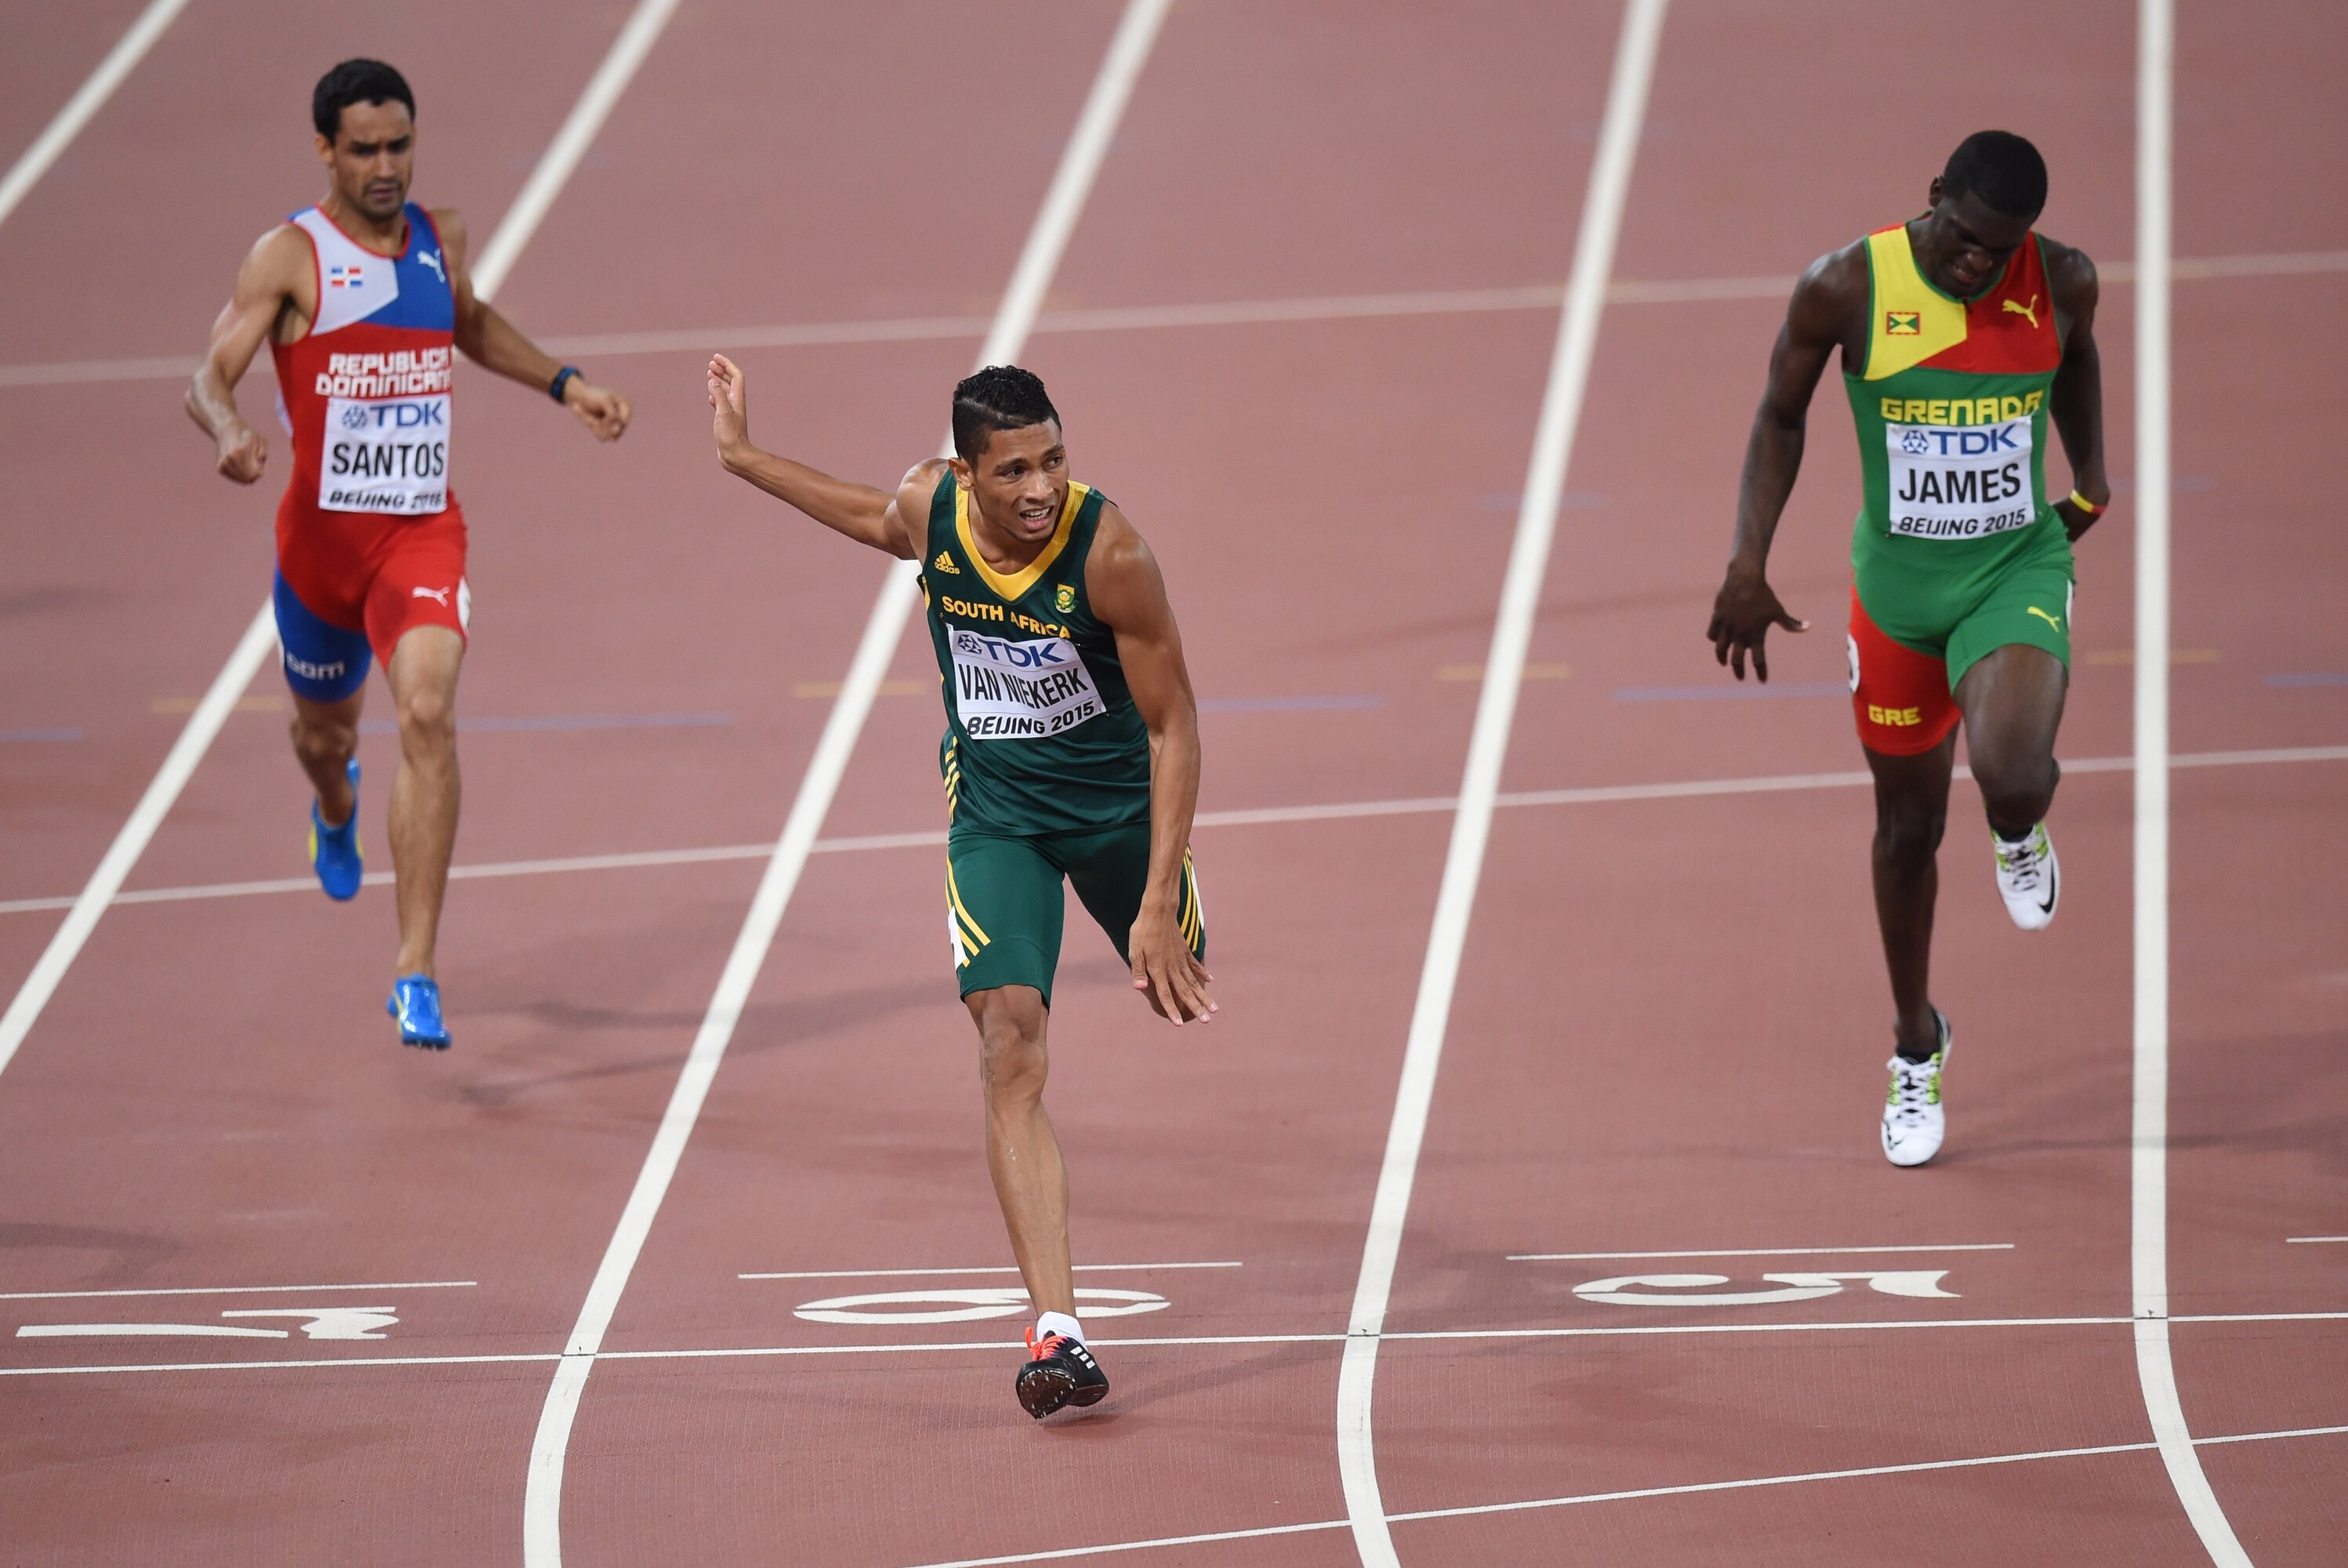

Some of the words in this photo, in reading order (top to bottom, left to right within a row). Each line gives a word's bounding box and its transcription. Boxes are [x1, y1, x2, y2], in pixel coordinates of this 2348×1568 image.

[315, 368, 452, 397] DOMINICAN
[369, 401, 444, 427] TDK
[1881, 390, 2043, 426] GRENADA
[1929, 424, 2018, 456] TDK
[332, 442, 445, 477] SANTOS
[329, 488, 406, 509] BEIJING
[1898, 463, 2021, 504] JAMES
[1899, 516, 1978, 535] BEIJING
[1983, 508, 2026, 534] 2015
[934, 561, 960, 575] adidas
[942, 596, 1003, 621] SOUTH
[1011, 611, 1071, 640] AFRICA
[978, 637, 1066, 668] TDK
[958, 663, 1002, 702] VAN
[1000, 667, 1089, 710] NIEKERK
[967, 715, 1045, 735] BEIJING
[1051, 701, 1094, 732] 2015
[1867, 704, 1921, 726] GRE
[1572, 1270, 1962, 1306] 5
[16, 1306, 399, 1340] 7
[793, 1288, 1171, 1324] 6
